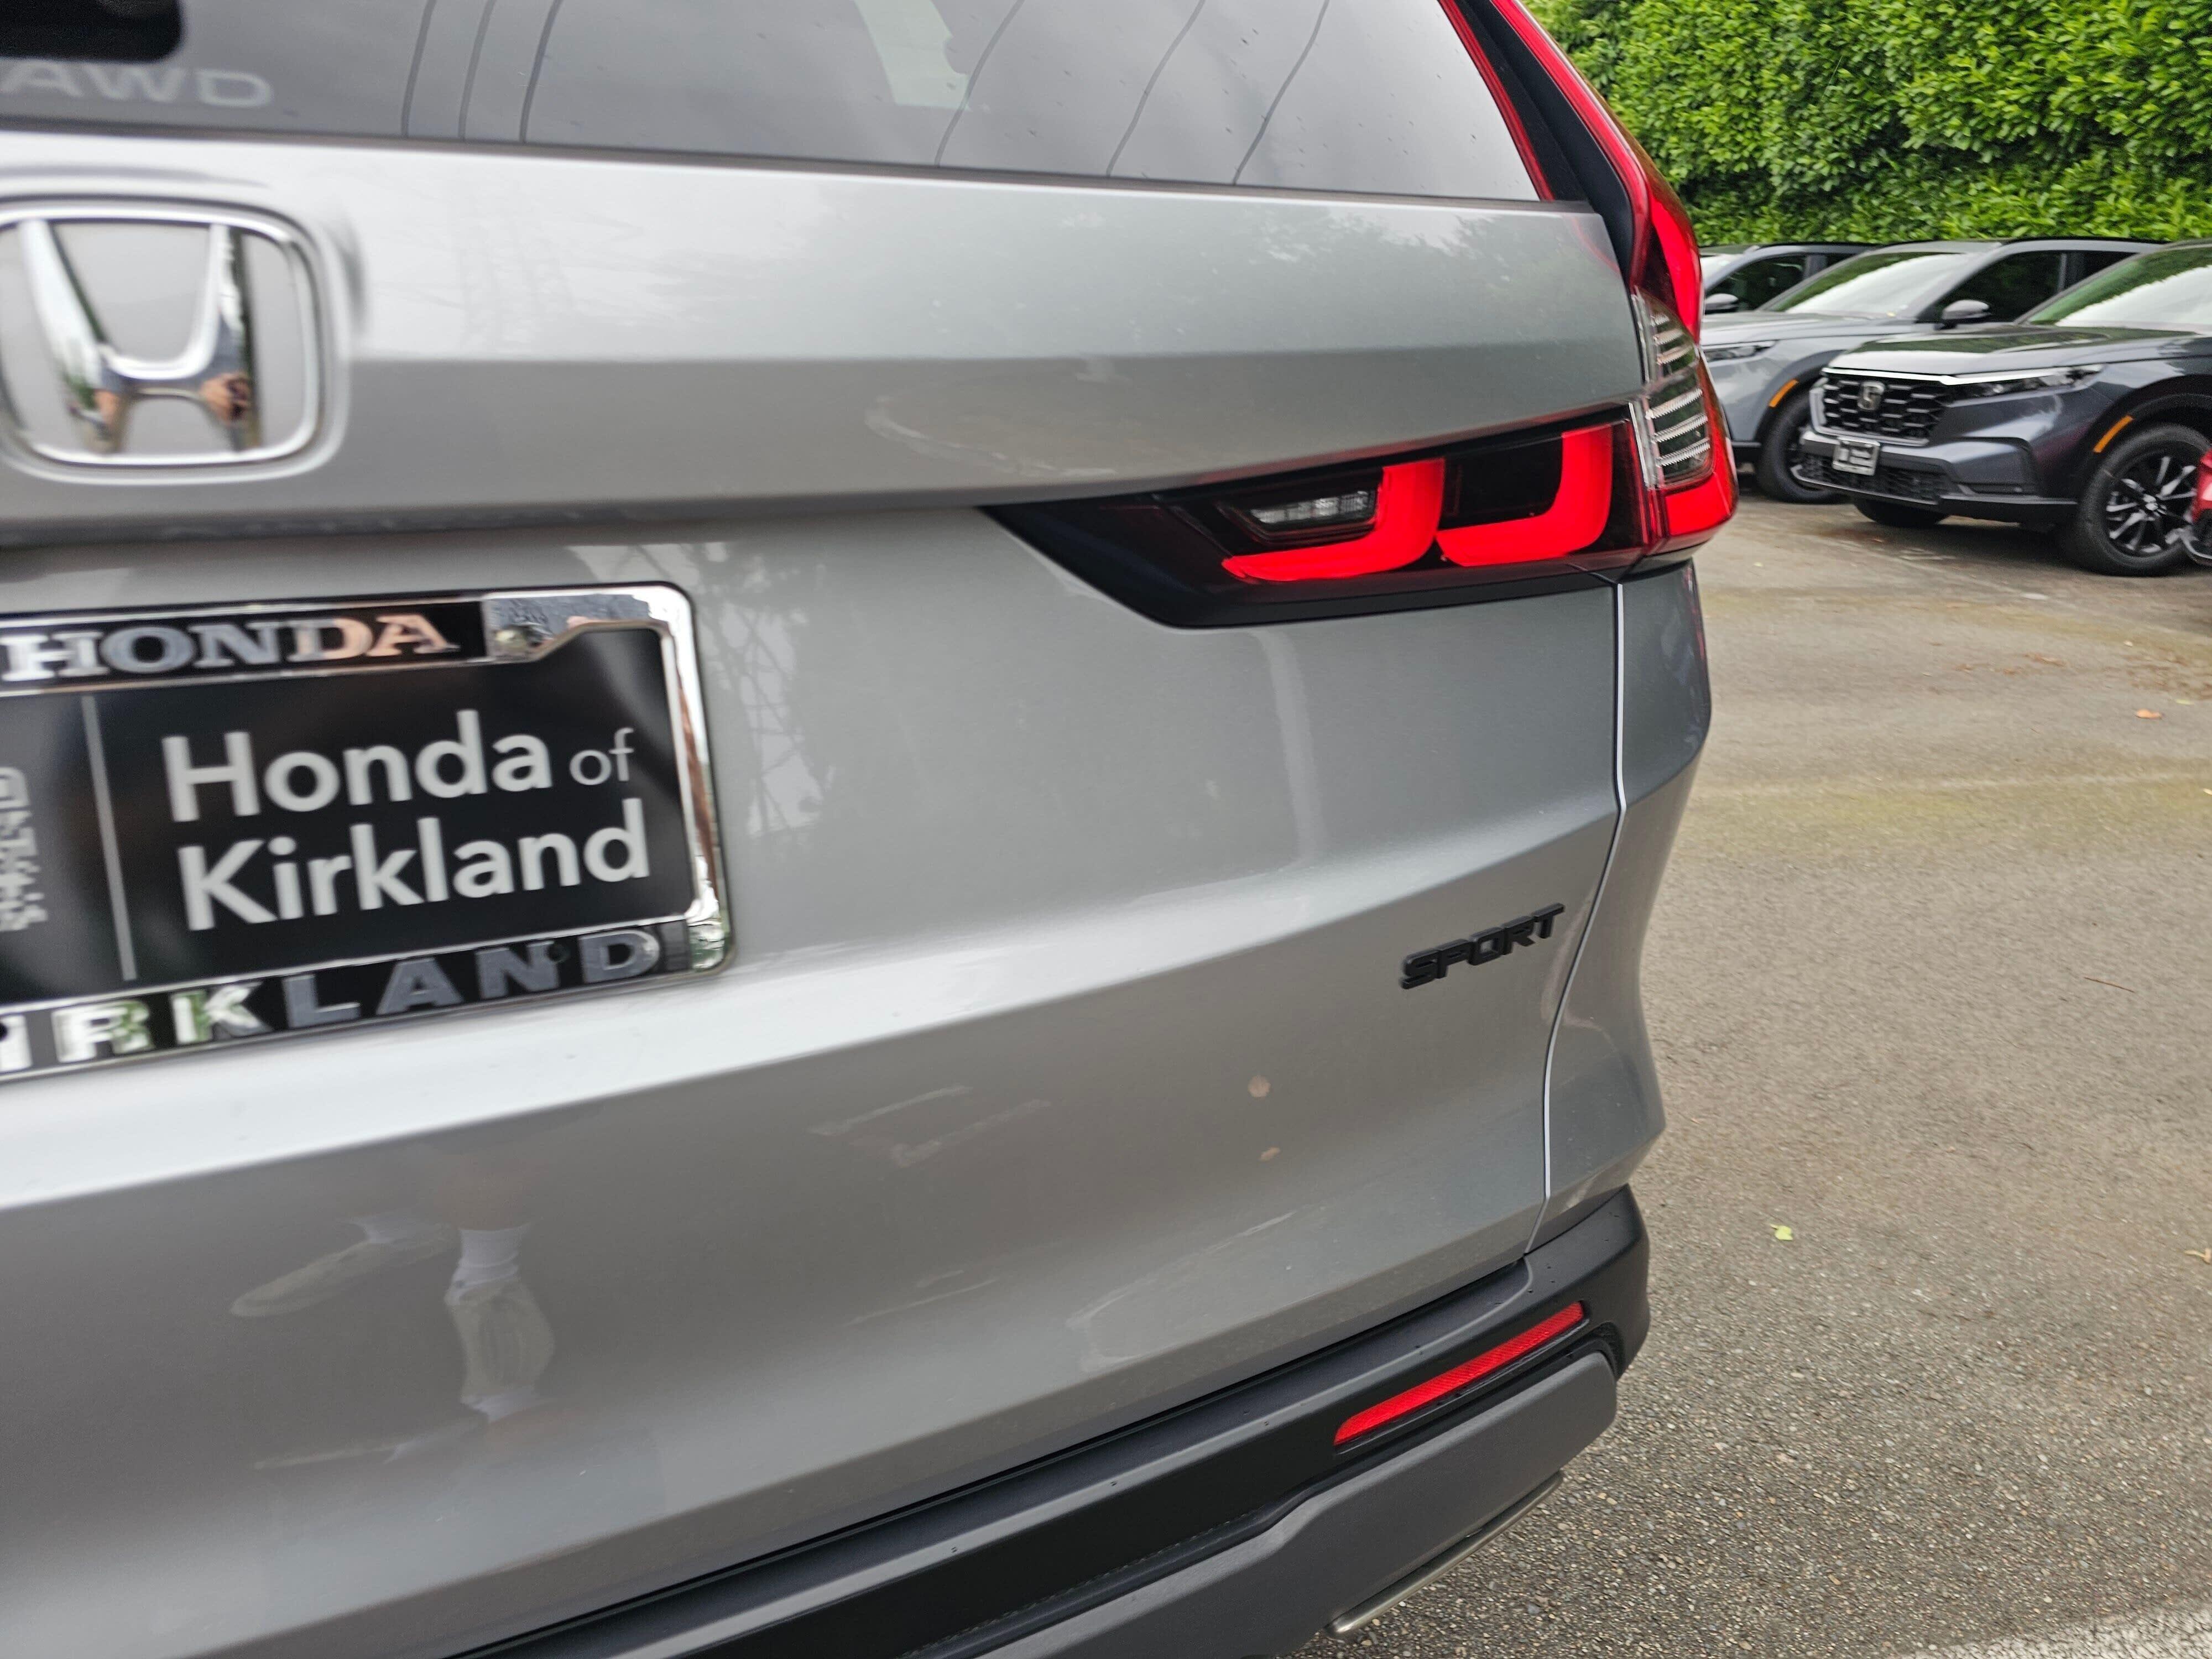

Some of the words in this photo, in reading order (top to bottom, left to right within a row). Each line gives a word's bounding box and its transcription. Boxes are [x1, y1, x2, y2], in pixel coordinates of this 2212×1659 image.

[0, 62, 274, 107] AWD
[0, 613, 461, 681] HONDA
[161, 709, 552, 822] Honda
[569, 727, 634, 786] of
[177, 797, 650, 931] Kirkland
[1399, 902, 1566, 990] SPORT
